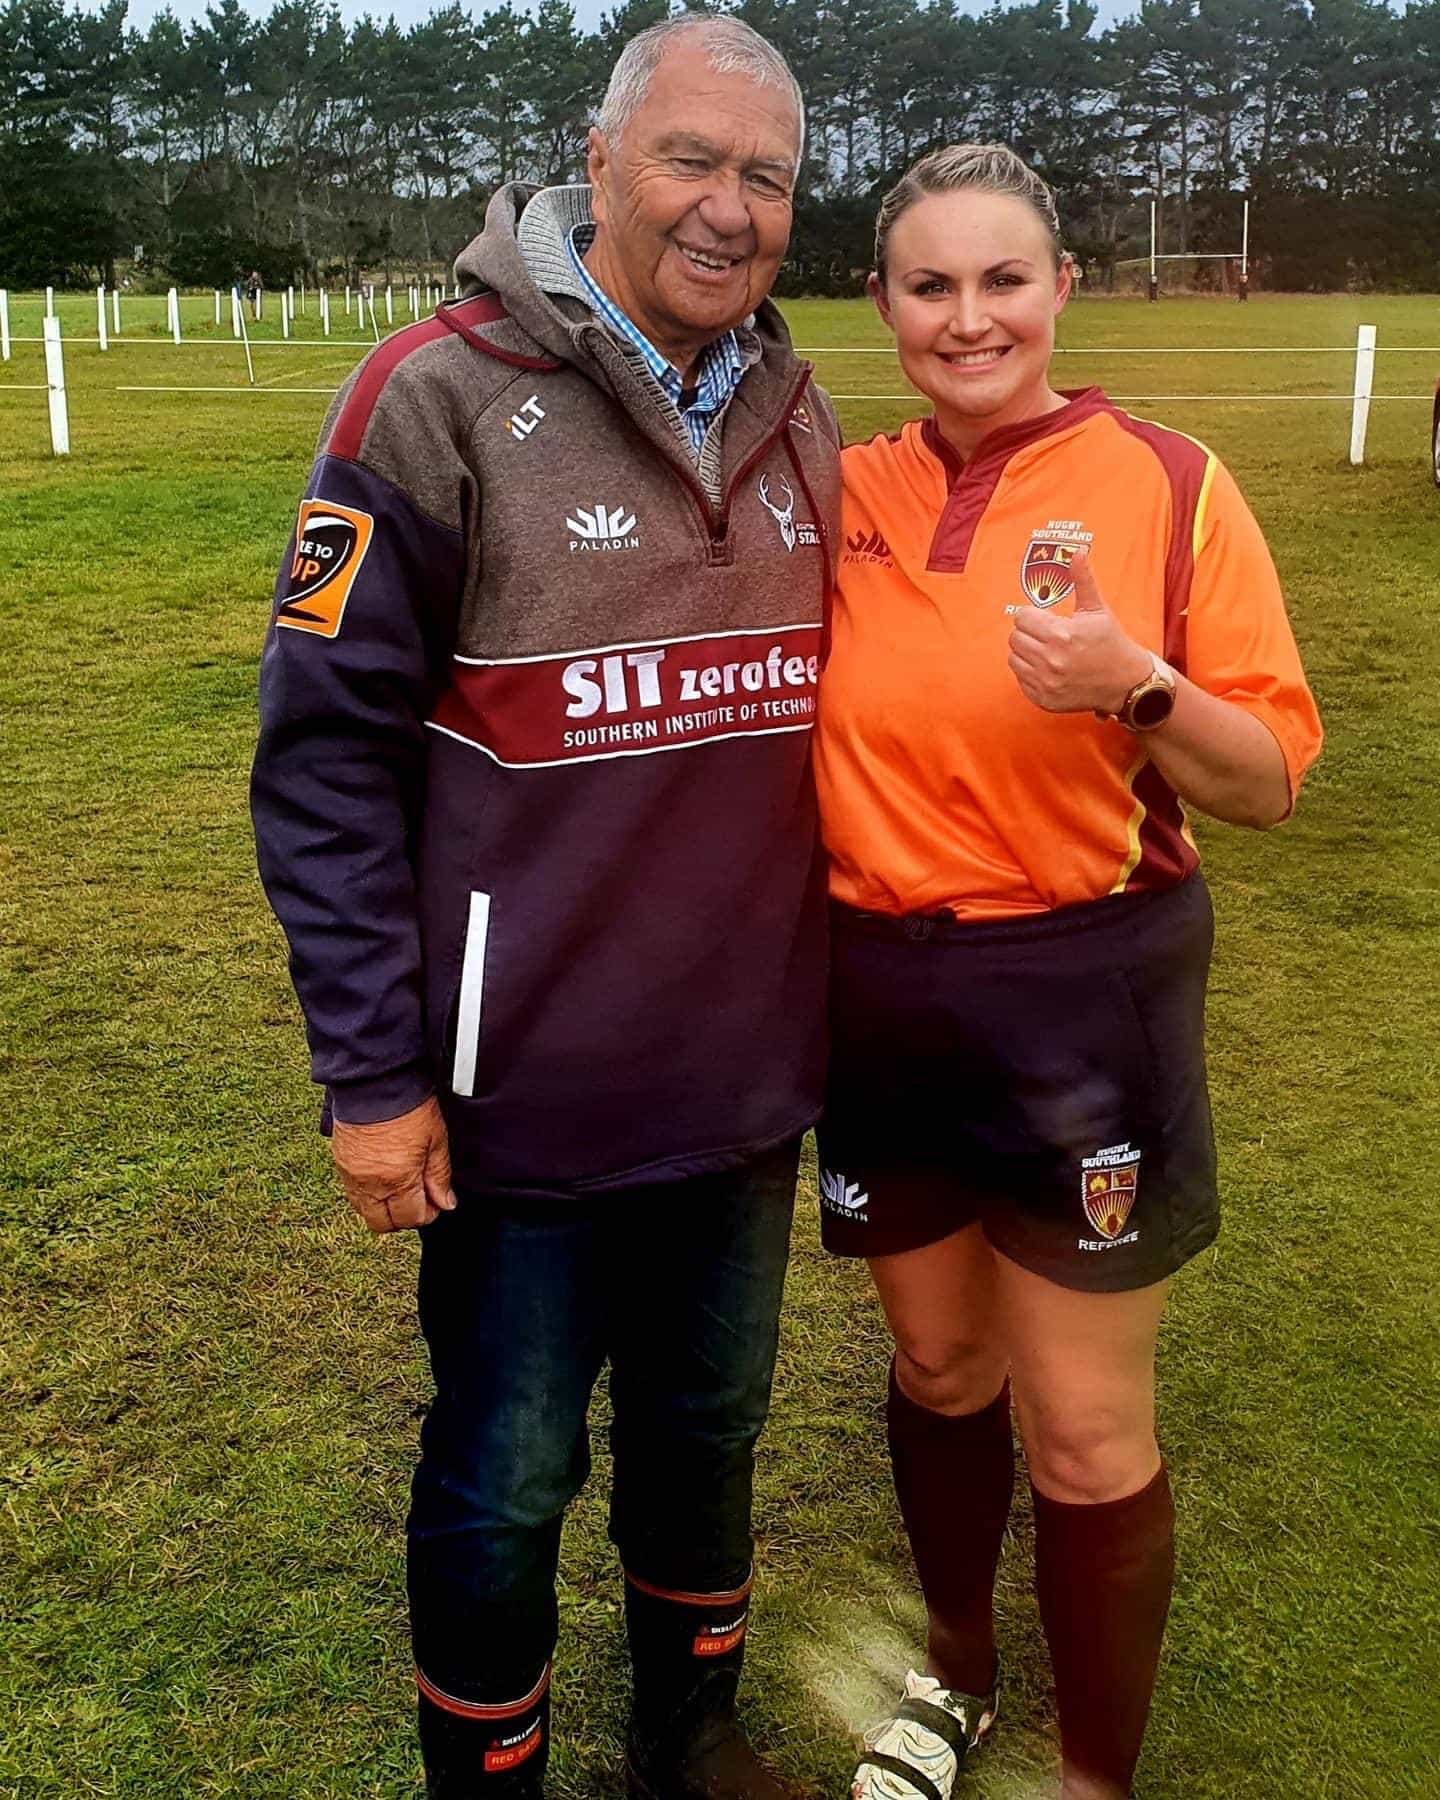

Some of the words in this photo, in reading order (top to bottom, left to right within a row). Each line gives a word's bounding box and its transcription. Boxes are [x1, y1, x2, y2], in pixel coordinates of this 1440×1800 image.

[569, 537, 640, 551] PALADIN
[1031, 529, 1094, 541] SOUTHLAND
[315, 543, 333, 559] 10
[562, 649, 665, 718] SIT
[680, 646, 817, 701] zerofee
[563, 720, 658, 747] SOUTHERN
[665, 706, 735, 735] INSTITUTE
[740, 703, 758, 720] OF
[1081, 1149, 1141, 1168] SOUTHLAND
[820, 1194, 868, 1222] ALADIN
